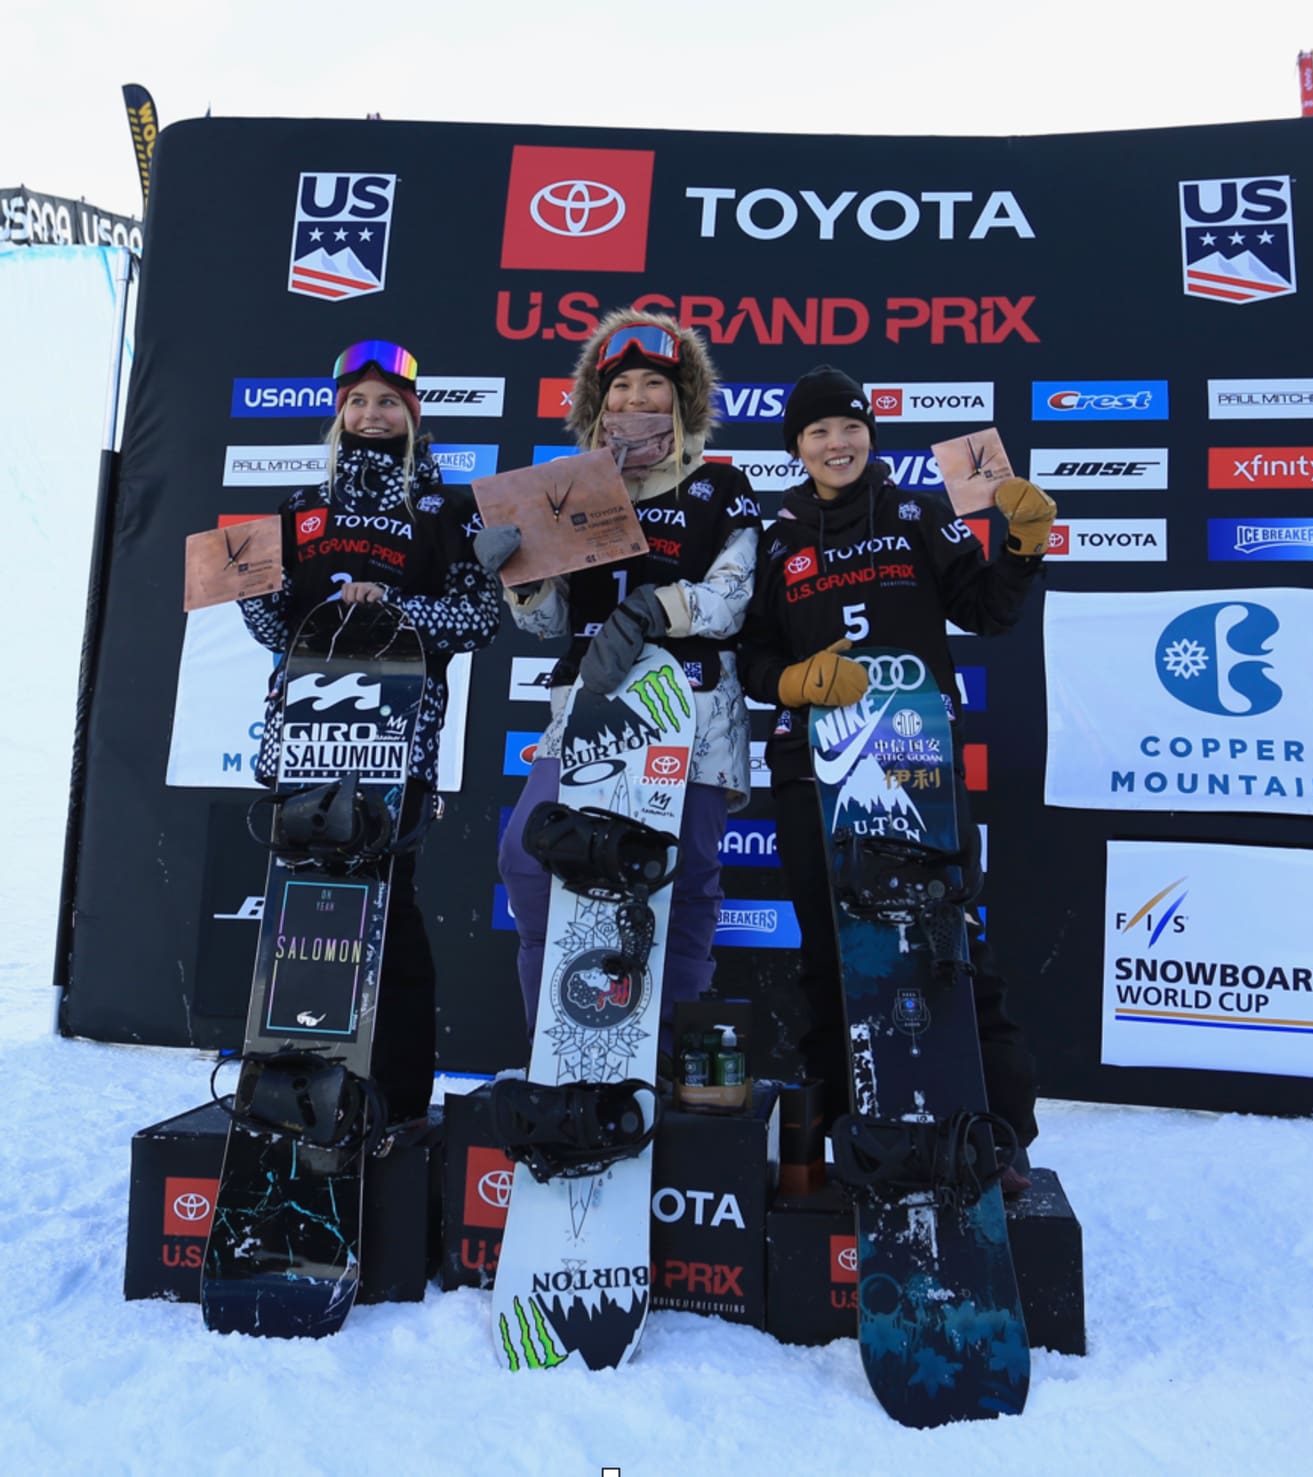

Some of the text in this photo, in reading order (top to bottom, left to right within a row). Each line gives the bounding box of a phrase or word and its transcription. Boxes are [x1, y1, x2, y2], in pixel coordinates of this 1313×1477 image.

[302, 176, 391, 218] US
[1183, 179, 1288, 223] US
[685, 187, 1036, 241] TOYOTA
[496, 290, 602, 341] U.S
[886, 295, 1041, 344] PRIX
[244, 387, 333, 408] USANA
[719, 388, 786, 417] VIS
[909, 395, 985, 409] TOYOTA
[1048, 390, 1153, 412] Crest
[1218, 393, 1260, 407] PAUL
[232, 460, 267, 472] PAUL
[433, 453, 475, 470] EAKERS
[888, 456, 944, 485] VIS
[1037, 461, 1160, 477] BOSE
[334, 514, 413, 540] TOYOTA
[636, 507, 686, 528] YOTA
[824, 535, 912, 563] TOYOTA
[1077, 533, 1158, 547] TOYOTA
[1238, 527, 1261, 545] ICE
[319, 537, 371, 556] GRAND
[372, 543, 407, 568] PRIX
[786, 564, 916, 604] U.S. GRAND PRIX
[842, 602, 870, 642] 5
[283, 722, 378, 742] GIRO
[815, 694, 875, 753] NIKE
[562, 726, 663, 770] BURTON
[1140, 735, 1305, 762] COPPER
[275, 935, 363, 964] SALOMON
[1116, 984, 1270, 1014] WORLD CUP
[652, 1187, 746, 1230] OTA
[162, 1244, 202, 1268] U.S
[532, 1265, 649, 1293] BURTON
[664, 1260, 744, 1297] PRIX
